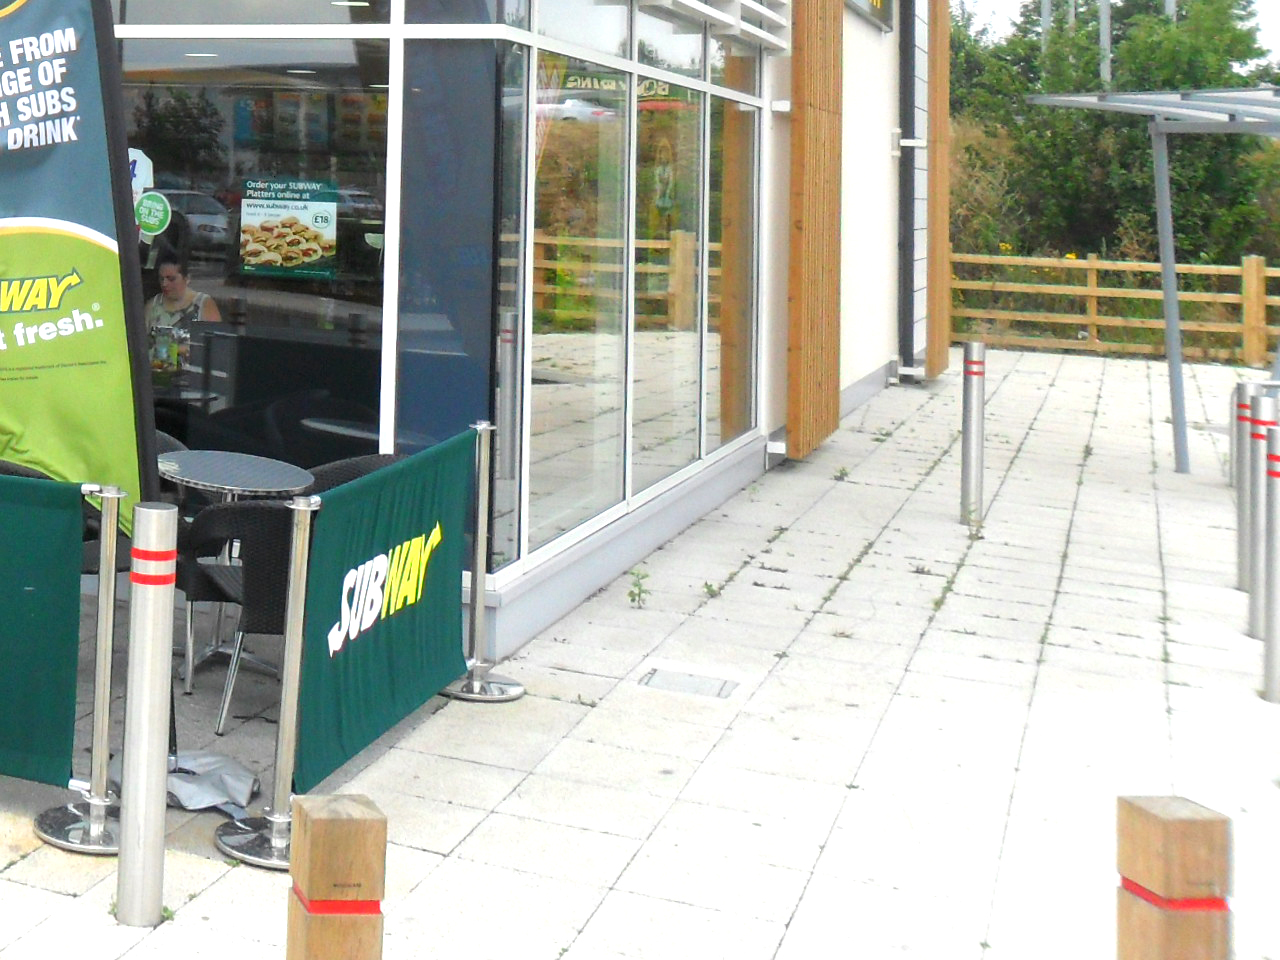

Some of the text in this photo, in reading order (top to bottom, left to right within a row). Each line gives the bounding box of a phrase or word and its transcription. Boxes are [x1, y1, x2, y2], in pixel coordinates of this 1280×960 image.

[9, 27, 77, 65] FROM
[37, 58, 67, 86] OF
[16, 87, 77, 122] SUBS
[246, 180, 321, 191] Order your SUBWAY
[246, 189, 276, 198] Platters
[276, 190, 301, 199] online
[327, 520, 442, 658] SUBWAY
